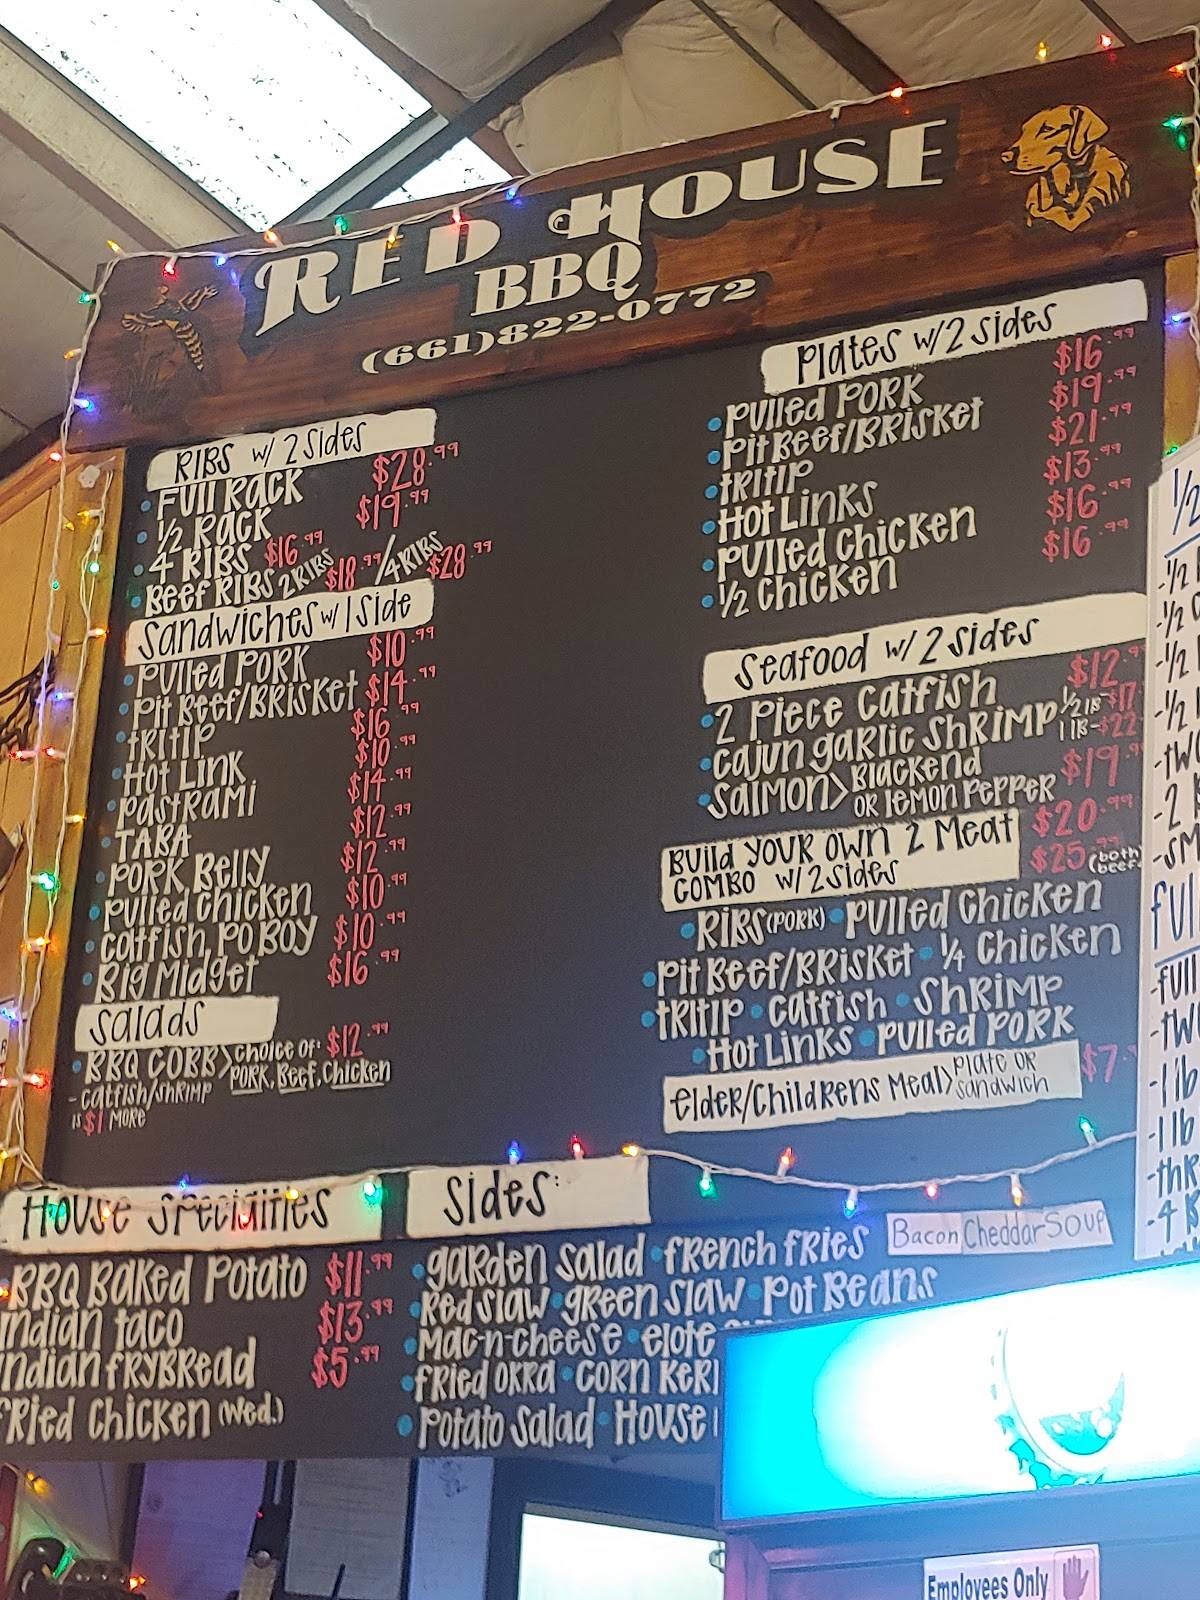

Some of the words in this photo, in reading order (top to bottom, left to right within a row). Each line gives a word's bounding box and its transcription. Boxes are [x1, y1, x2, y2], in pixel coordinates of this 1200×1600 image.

[255, 219, 500, 336] RED
[548, 119, 948, 245] HOUSE
[470, 242, 644, 316] BBQ
[361, 278, 758, 376] (661)822-0772
[835, 373, 925, 418] PORK
[1050, 327, 1136, 376] $16.99
[1048, 365, 1138, 413] $19.99
[1047, 402, 1134, 447] $21.99
[284, 433, 299, 465] 2
[371, 442, 460, 493] $28.99
[1043, 442, 1122, 486] $13.99
[355, 489, 430, 530] $19.99
[1045, 477, 1133, 521] $16.99
[149, 552, 174, 585] 4
[182, 543, 254, 582] RIBS
[264, 530, 324, 568] $16.99
[1041, 517, 1130, 564] $16.99
[216, 570, 275, 607] RIBS
[236, 645, 311, 687] PORK
[366, 626, 436, 668] $10.99
[365, 665, 437, 707] $14.99
[350, 701, 421, 742] $16.99
[713, 702, 737, 747] 2
[354, 734, 417, 770] $10.99
[347, 767, 413, 804] $14.99
[114, 822, 193, 862] TABA
[350, 802, 412, 839] $12.99
[905, 820, 926, 857] 2
[107, 858, 190, 898] PORK
[340, 837, 407, 874] $12.99
[673, 867, 757, 907] COMBO
[346, 873, 408, 910] $10.99
[334, 910, 407, 951] $10.99
[328, 948, 400, 988] $16.99
[986, 1004, 1076, 1042] PORK
[85, 1048, 140, 1085] BBQ
[892, 1219, 959, 1251] Bacon
[964, 1213, 1045, 1251] Cheddar
[8, 1262, 81, 1310] BBQ
[324, 1250, 393, 1298] $11.99
[317, 1298, 394, 1344] $13.99
[310, 1344, 380, 1389] $5.99
[1013, 1565, 1049, 1600] Only
